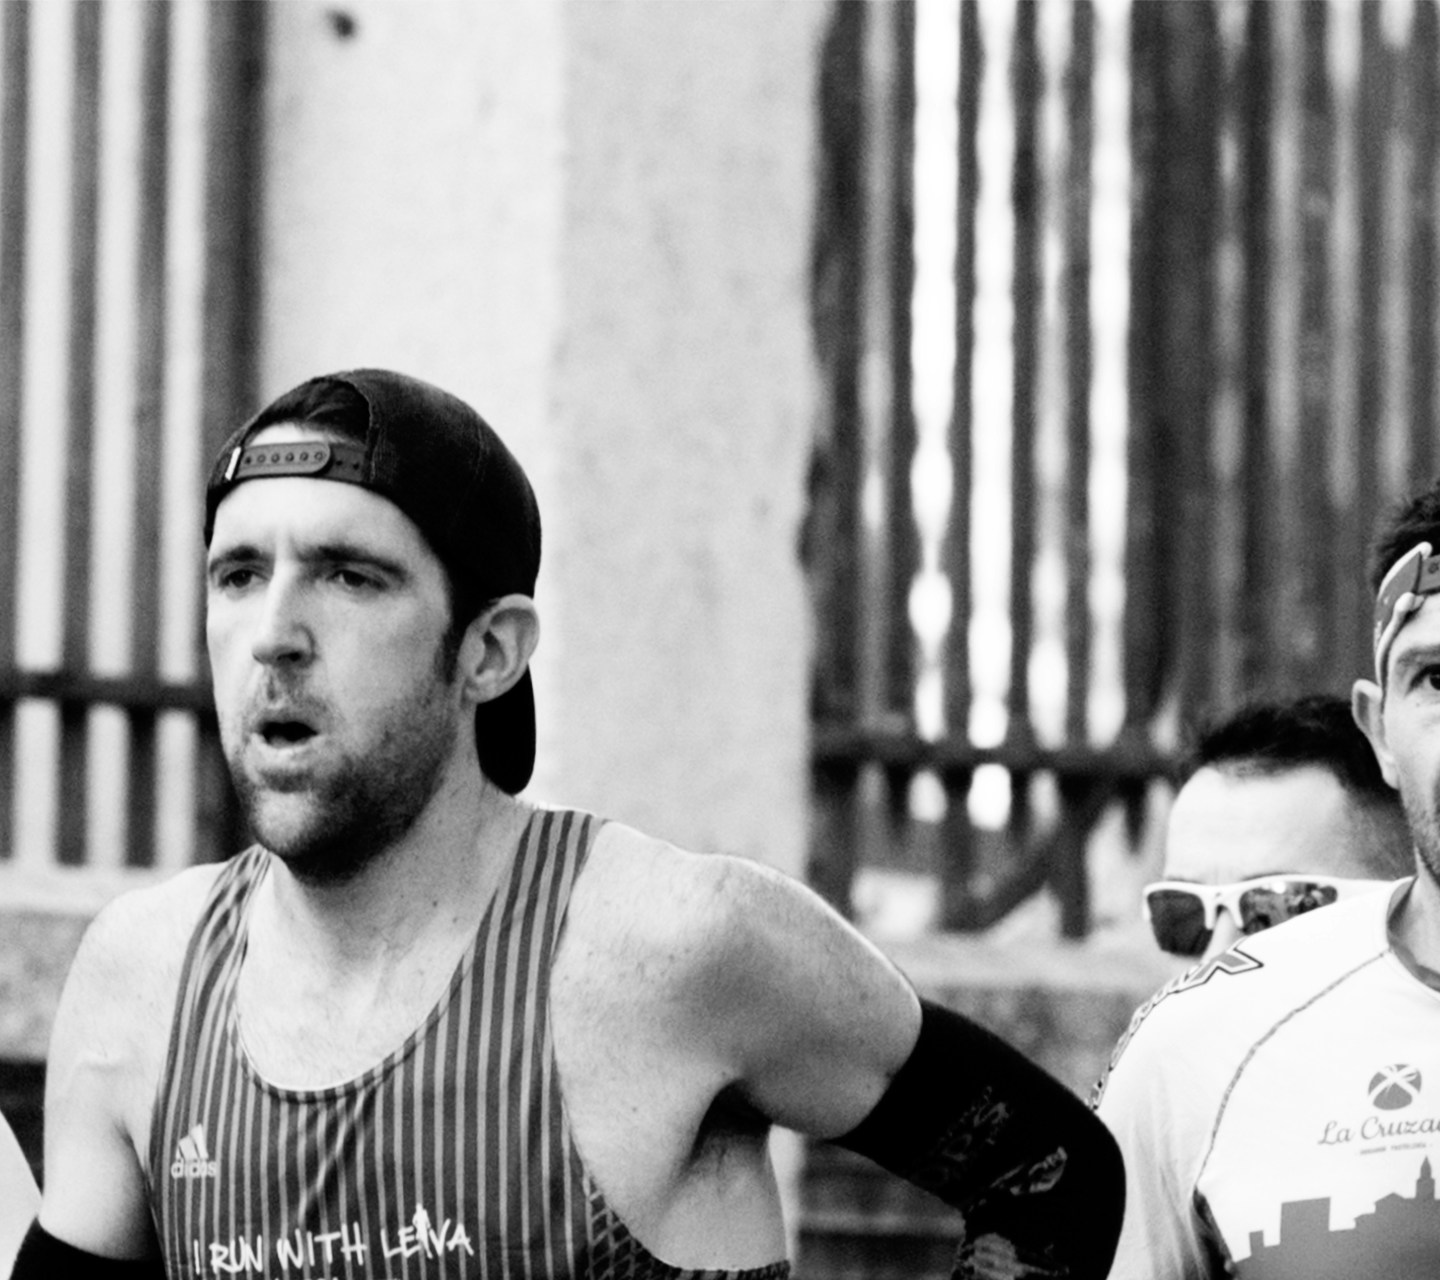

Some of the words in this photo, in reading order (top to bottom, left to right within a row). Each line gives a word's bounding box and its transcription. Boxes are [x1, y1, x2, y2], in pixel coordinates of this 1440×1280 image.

[1318, 1120, 1354, 1145] La
[193, 1239, 201, 1275] I
[210, 1235, 264, 1274] RUN
[276, 1221, 367, 1270] WITH
